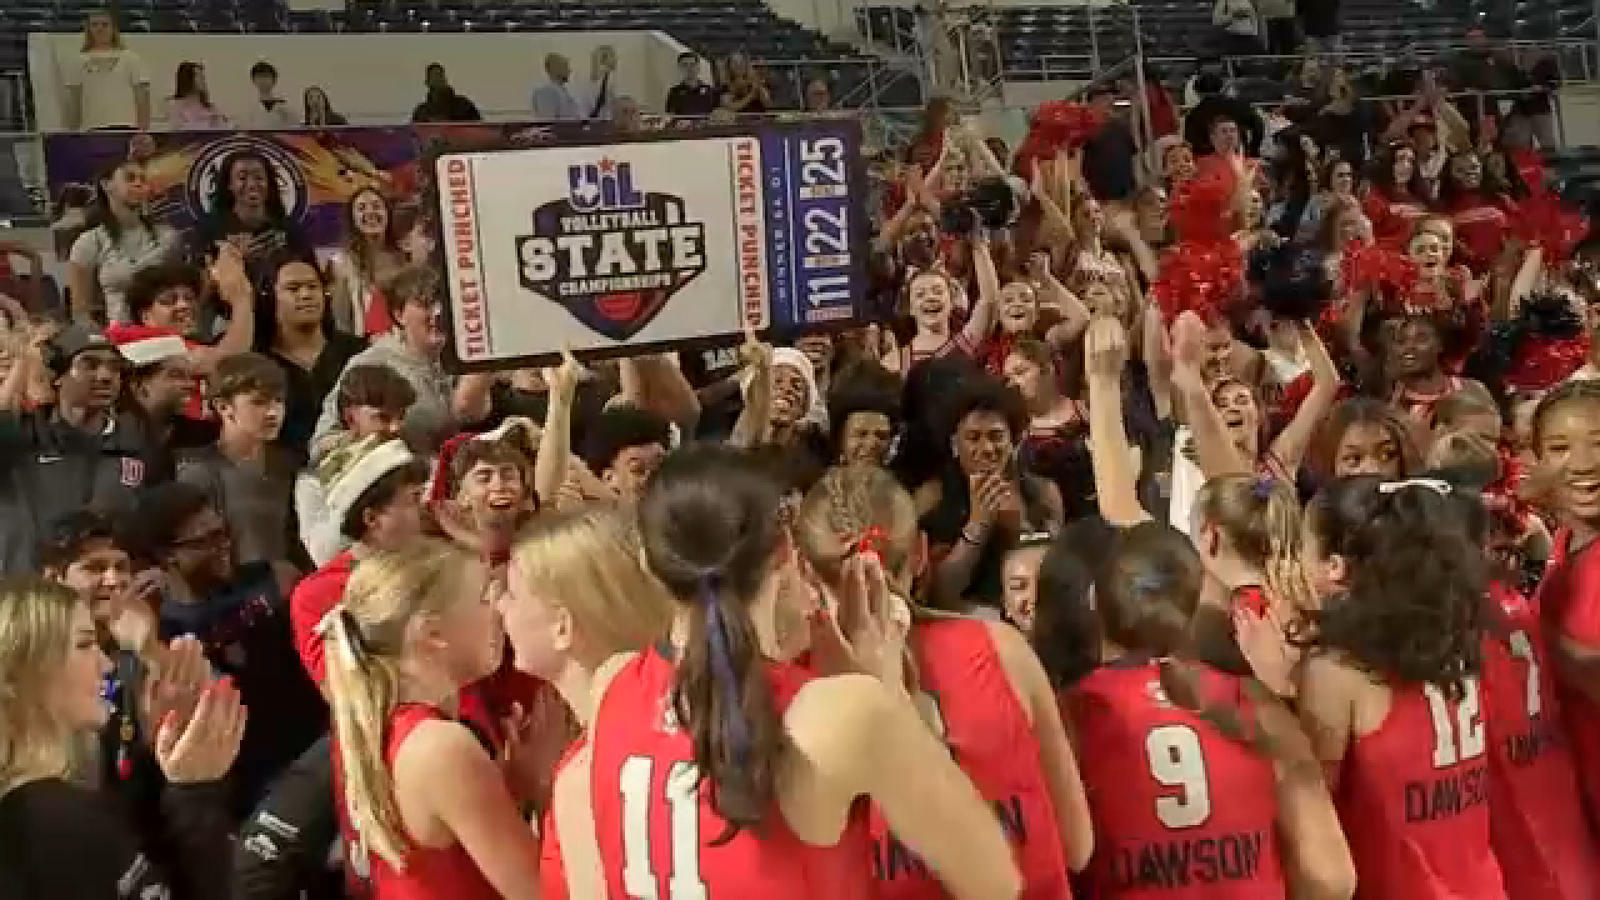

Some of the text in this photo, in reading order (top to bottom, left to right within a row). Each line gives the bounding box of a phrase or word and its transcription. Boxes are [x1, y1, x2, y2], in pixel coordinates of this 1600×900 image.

[800, 139, 845, 184] 25
[447, 158, 486, 358] TICKET PUNCHED
[520, 226, 704, 281] STATE
[738, 141, 763, 327] TICKET PUNCHED
[804, 206, 849, 253] 22
[807, 276, 851, 307] 11
[1423, 675, 1487, 770] 12
[1146, 724, 1211, 829] 9
[619, 754, 710, 900] 11
[1109, 830, 1264, 888] DAWSON
